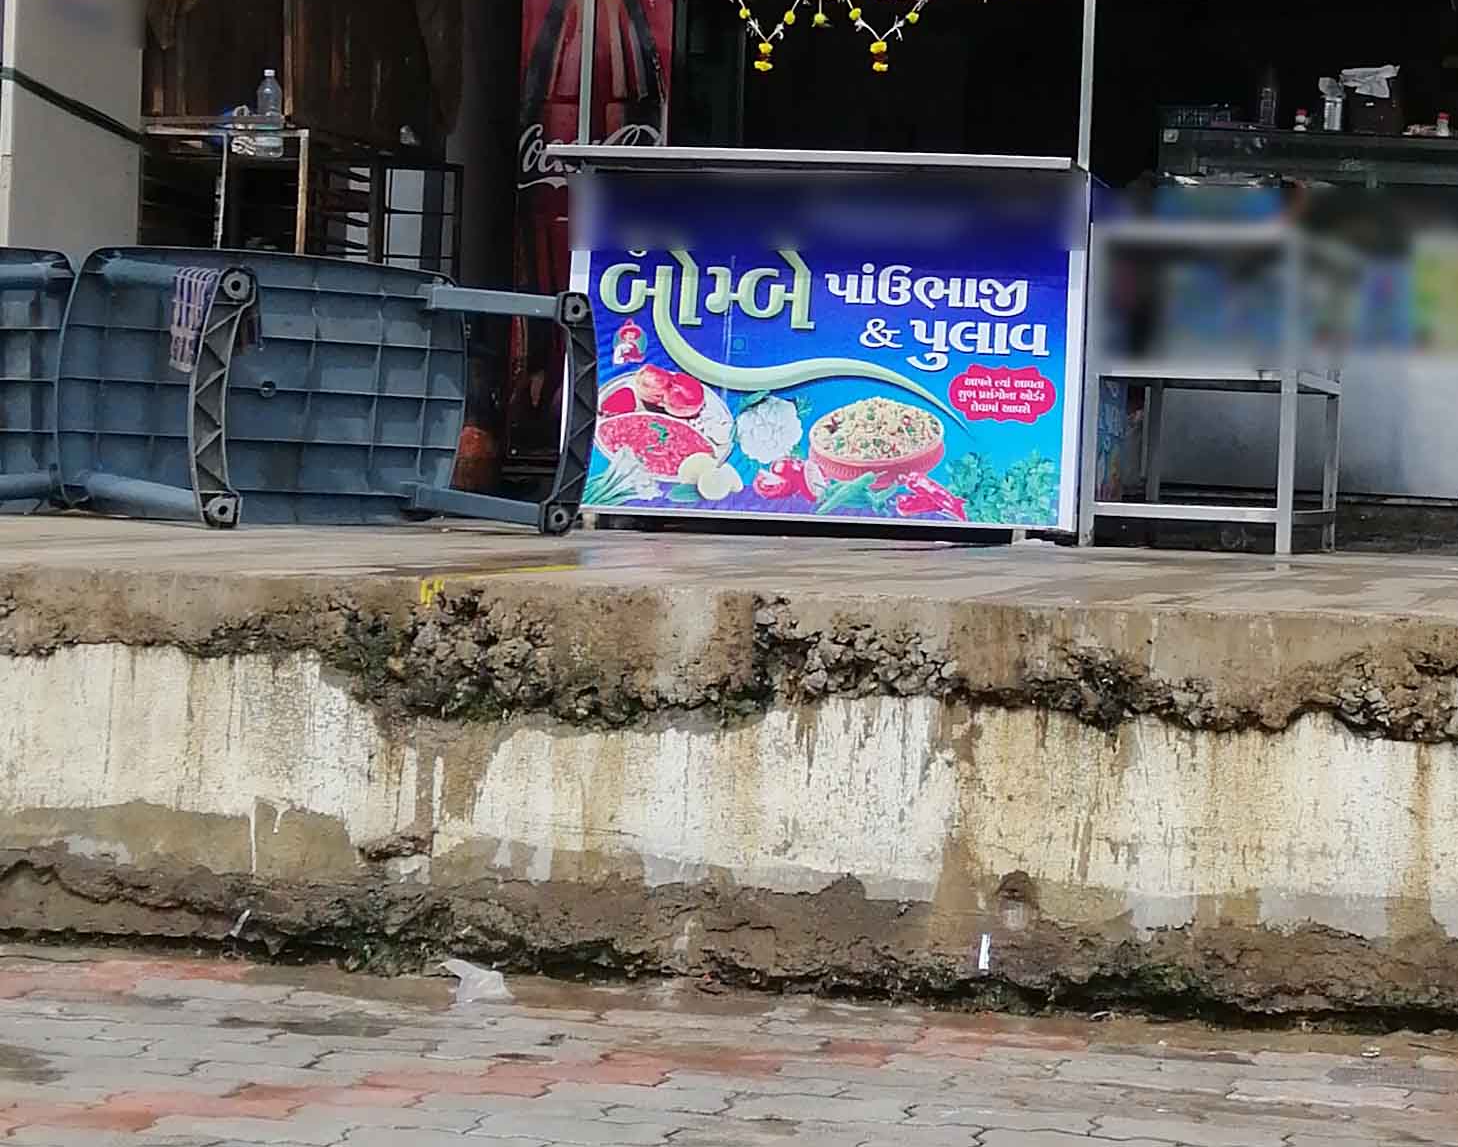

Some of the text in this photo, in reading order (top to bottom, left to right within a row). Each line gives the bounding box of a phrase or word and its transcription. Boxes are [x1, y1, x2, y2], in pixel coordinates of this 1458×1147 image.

[825, 263, 1029, 317] પાંઉભાજી
[859, 317, 1050, 372] & પુલાવ
